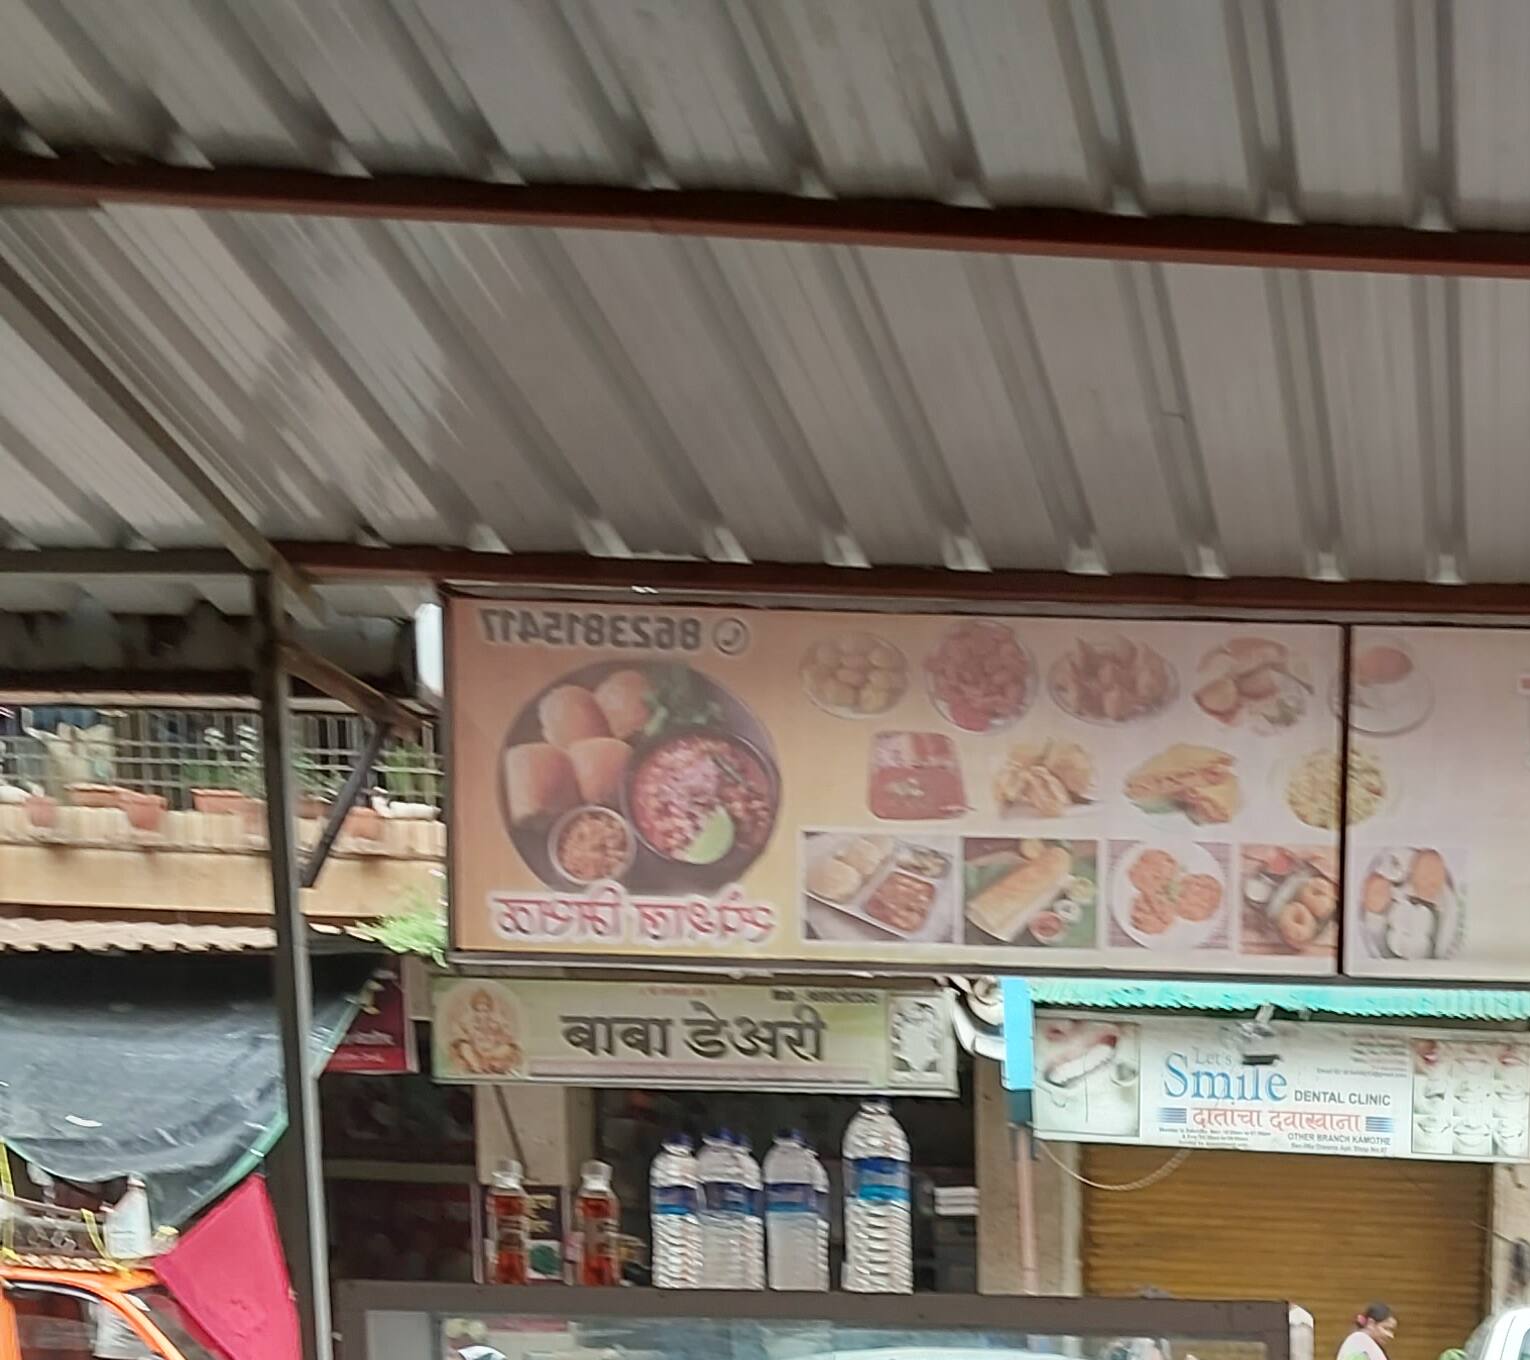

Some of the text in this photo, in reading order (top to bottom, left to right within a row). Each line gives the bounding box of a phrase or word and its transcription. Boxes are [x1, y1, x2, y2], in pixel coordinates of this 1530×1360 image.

[561, 1001, 827, 1061] बाबा डेअरी
[1163, 1052, 1391, 1107] Smile DENTAL CLINIC
[1268, 1109, 1361, 1132] दवाखाना
[1287, 1132, 1392, 1146] OTHER BRANCH KAMOTHE
